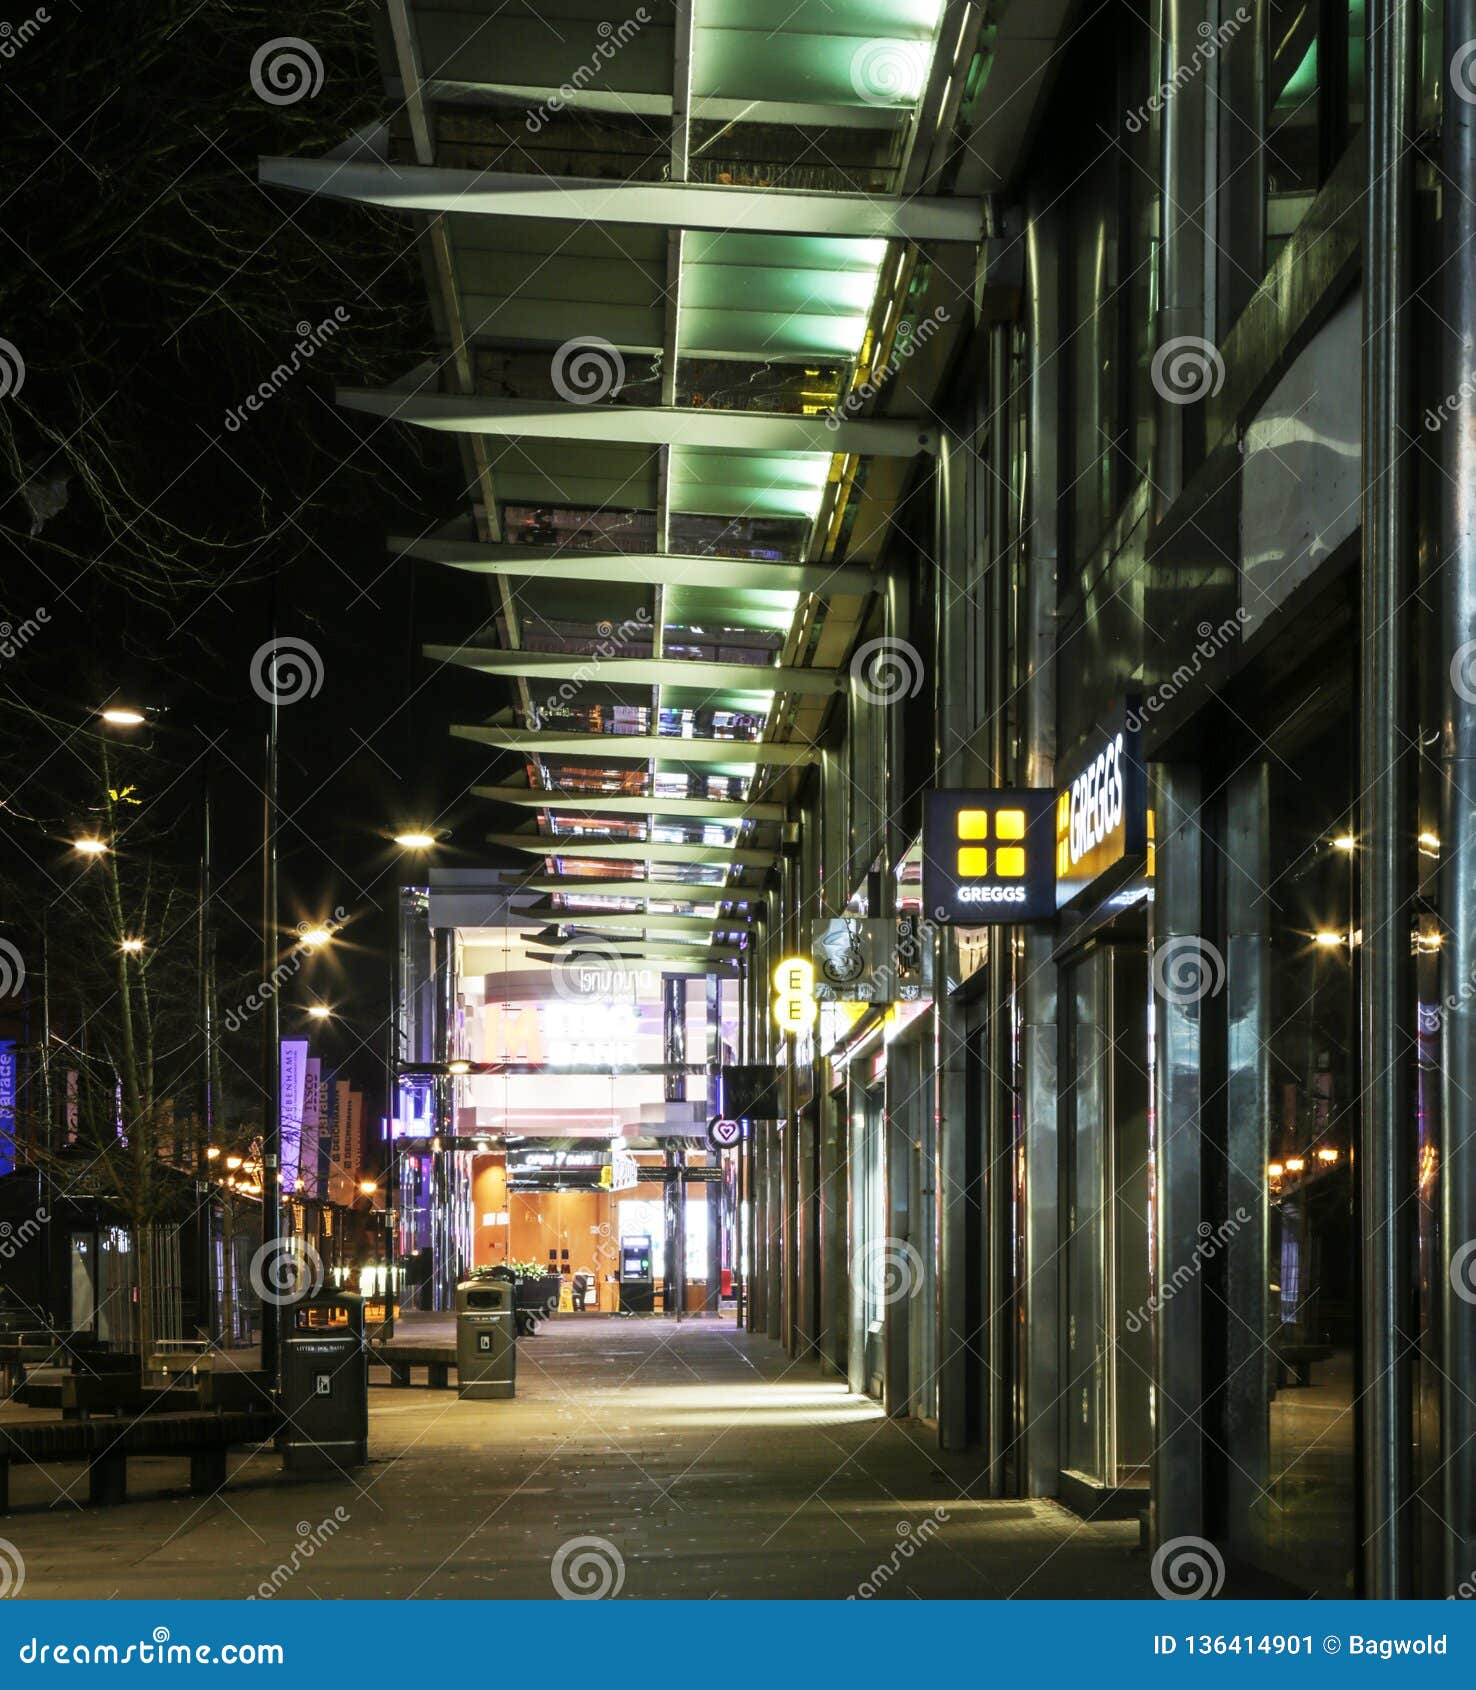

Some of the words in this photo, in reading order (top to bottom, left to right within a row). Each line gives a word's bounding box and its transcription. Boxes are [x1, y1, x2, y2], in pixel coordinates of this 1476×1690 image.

[1070, 733, 1123, 864] GREGGS
[957, 886, 1027, 902] GREGGS
[285, 1050, 294, 1120] DEBENHAMS
[304, 1074, 313, 1112] TESCO
